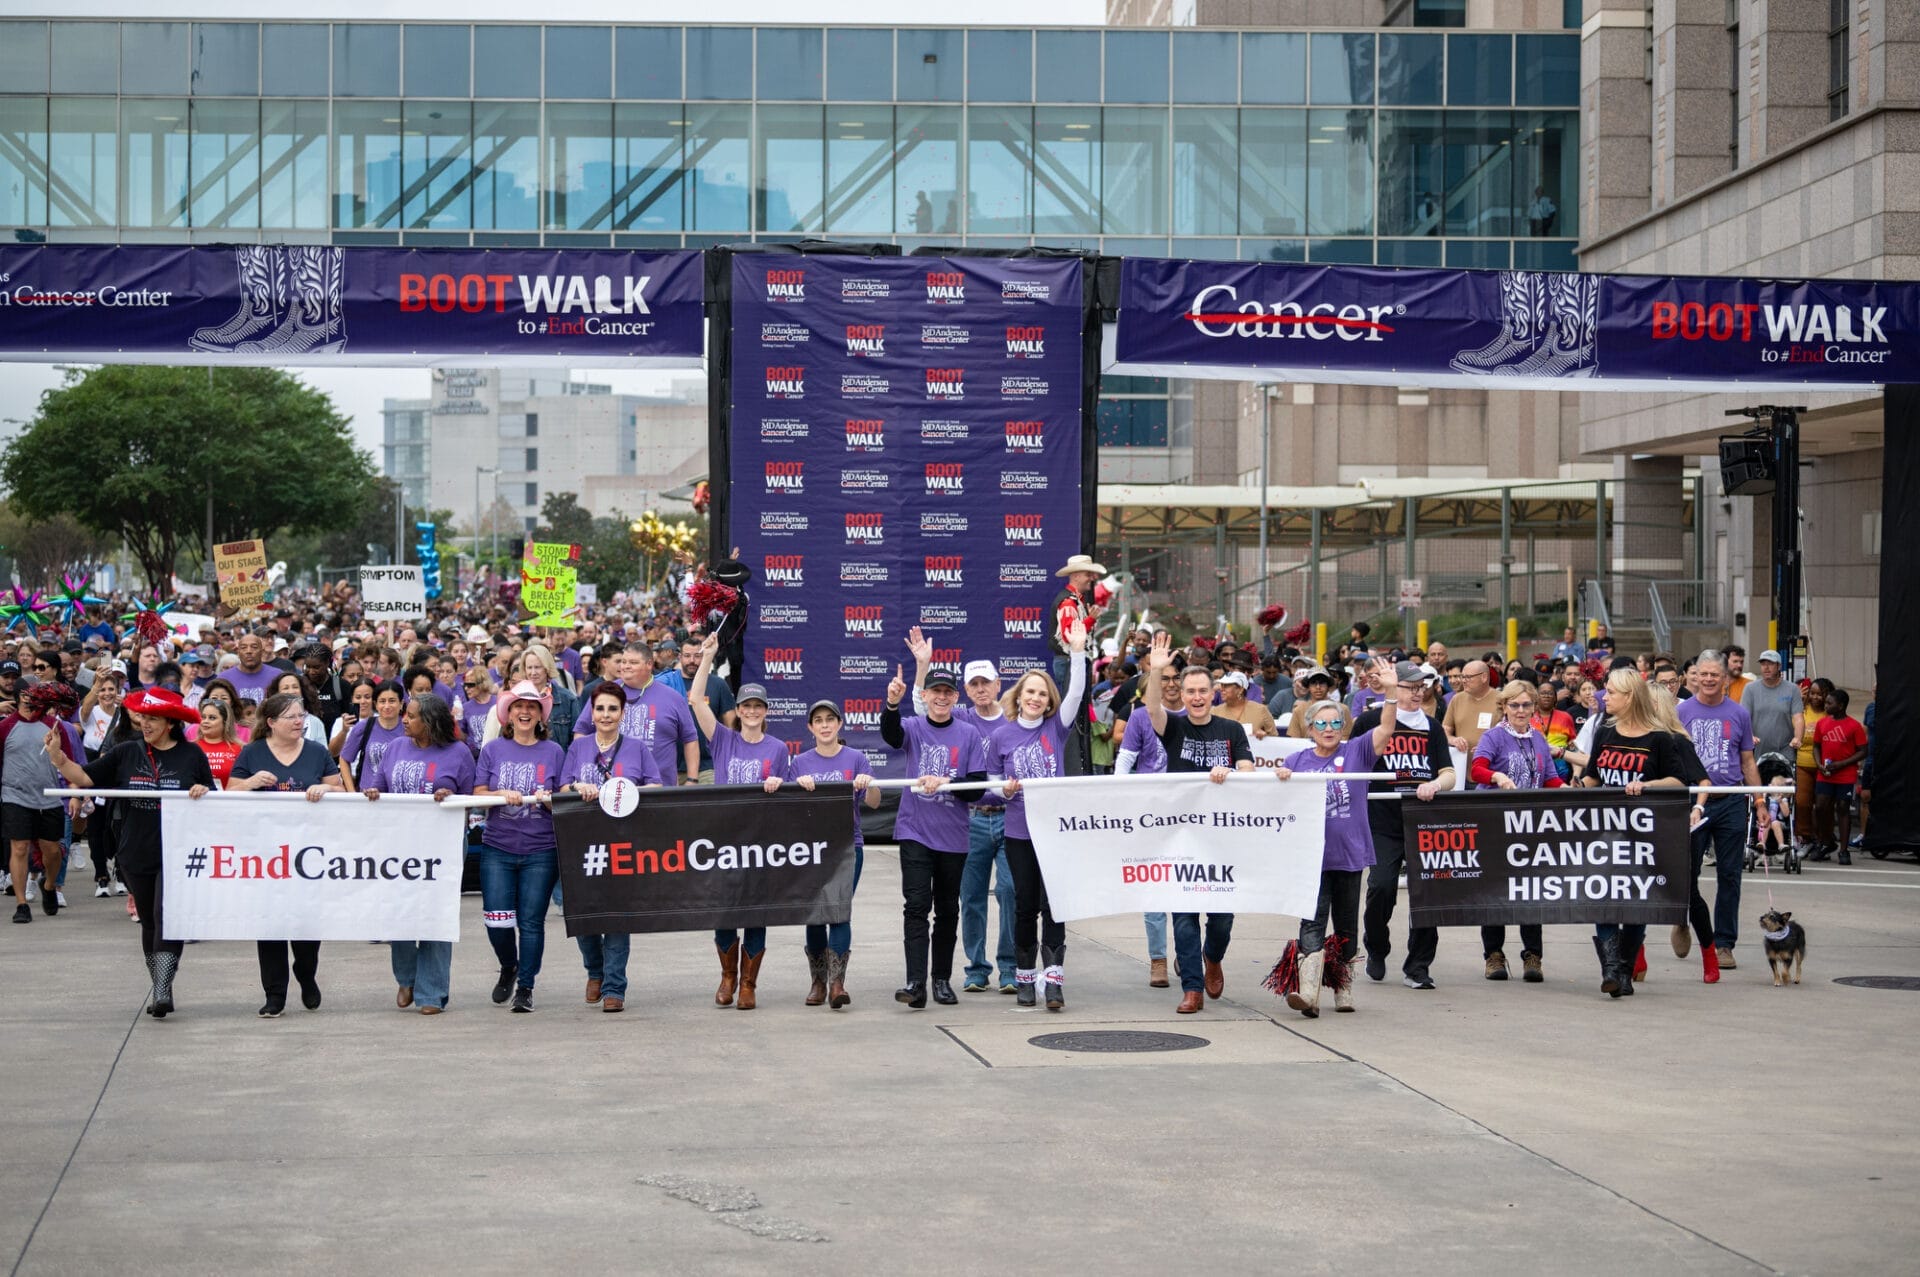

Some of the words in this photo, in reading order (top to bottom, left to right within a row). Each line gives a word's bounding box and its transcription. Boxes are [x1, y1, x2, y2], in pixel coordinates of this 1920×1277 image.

[767, 270, 804, 284] BOOT
[927, 273, 964, 287] BOOT
[14, 285, 96, 306] Cancer
[99, 286, 172, 307] Center
[400, 274, 513, 313] BOOT
[518, 275, 651, 314] WALK
[767, 284, 805, 295] WALK
[927, 287, 965, 298] WALK
[518, 318, 536, 334] to
[1652, 301, 1758, 342] BOOT
[1763, 304, 1888, 343] WALK
[847, 325, 884, 339] BOOT
[1006, 327, 1043, 341] BOOT
[847, 339, 885, 350] WALK
[1006, 341, 1044, 352] WALK
[1761, 347, 1778, 362] to
[766, 367, 803, 381] BOOT
[926, 368, 963, 382] BOOT
[766, 381, 804, 392] WALK
[926, 382, 964, 393] WALK
[846, 420, 883, 434] BOOT
[1006, 421, 1043, 435] BOOT
[846, 434, 884, 445] WALK
[1006, 435, 1044, 446] WALK
[766, 462, 803, 476] BOOT
[926, 464, 963, 478] BOOT
[766, 476, 804, 487] WALK
[926, 478, 964, 489] WALK
[846, 513, 883, 527] BOOT
[1005, 514, 1042, 528] BOOT
[846, 527, 884, 538] WALK
[1005, 528, 1043, 539] WALK
[537, 546, 569, 557] STOMP
[218, 560, 234, 570] OUT
[238, 556, 263, 568] STAGE
[540, 555, 558, 565] OUT
[765, 555, 802, 569] BOOT
[925, 556, 962, 570] BOOT
[360, 569, 415, 580] SYMPTOM
[535, 567, 565, 576] STAGE
[765, 569, 803, 580] WALK
[925, 570, 963, 581] WALK
[228, 585, 260, 596] BREAST
[531, 591, 566, 601] BREAST
[230, 595, 264, 607] CANCER
[363, 602, 422, 612] RESEARCH
[528, 600, 566, 610] CANCER
[845, 606, 882, 620] BOOT
[1004, 607, 1041, 621] BOOT
[845, 620, 883, 631] WALK
[1004, 621, 1042, 632] WALK
[765, 648, 802, 662] BOOT
[765, 662, 803, 673] WALK
[844, 699, 881, 713] BOOT
[844, 713, 882, 724] WALK
[1383, 735, 1429, 755] BOOT
[1206, 755, 1230, 767] SHOES
[1384, 754, 1431, 770] WALK
[1597, 749, 1648, 773] BOOT
[1597, 767, 1644, 787] WALK
[1339, 780, 1350, 804] WALK
[1058, 815, 1133, 833] Making
[1139, 813, 1206, 828] Cancer
[1503, 807, 1655, 834] MAKING
[1418, 829, 1478, 852] BOOT
[582, 839, 828, 877] #EndCancer
[1420, 850, 1480, 869] WALK
[1506, 841, 1655, 867] CANCER
[185, 844, 441, 881] #EndCancer
[1122, 864, 1172, 883] BOOT
[1174, 864, 1235, 883] WALK
[1420, 871, 1430, 880] to
